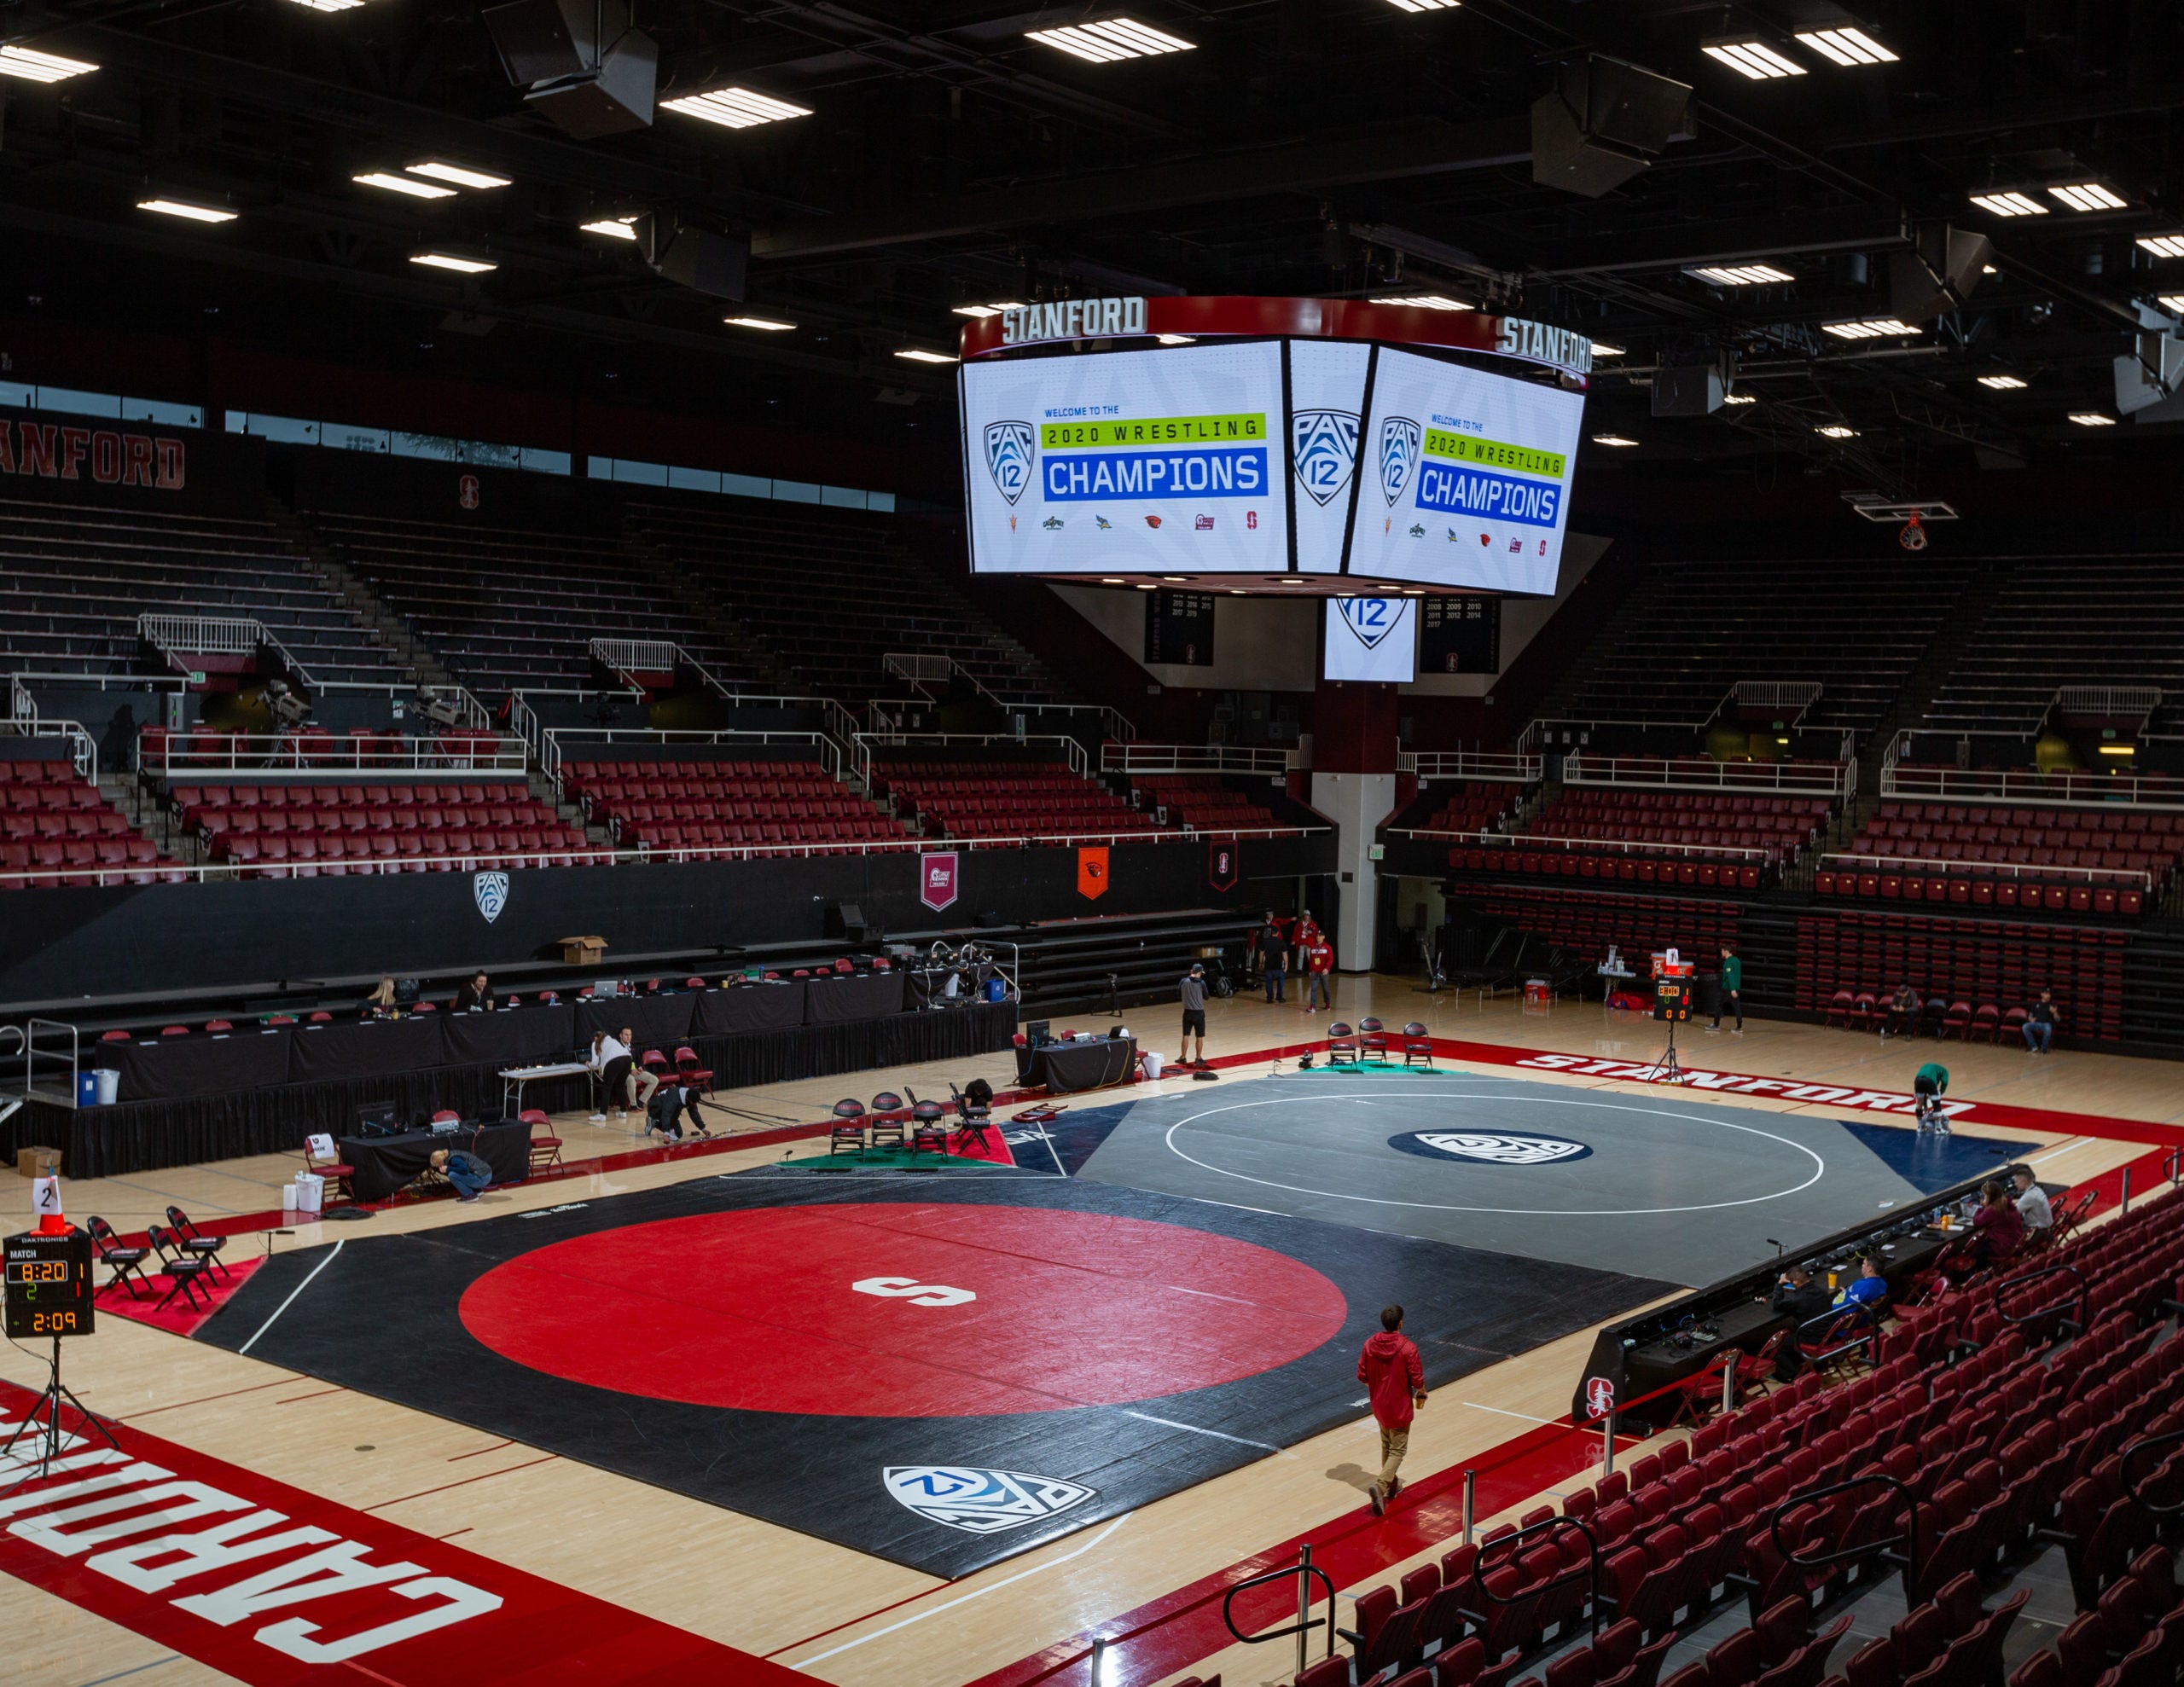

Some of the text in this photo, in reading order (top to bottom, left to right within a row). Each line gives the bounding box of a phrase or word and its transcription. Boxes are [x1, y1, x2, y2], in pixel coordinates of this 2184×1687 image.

[1002, 296, 1147, 344] STANFORD
[1502, 316, 1592, 374] STANFORD
[1045, 405, 1119, 417] WELCOME TO THE
[1432, 414, 1484, 432] WELCOME TO THE
[1048, 420, 1257, 443] 2020 WRESTLING
[1429, 435, 1560, 473] 2020 WRESTLING
[1002, 464, 1021, 488] 12
[1048, 455, 1260, 495] CHAMPIONS
[1310, 460, 1339, 485] 12
[1387, 464, 1403, 489] 12
[1420, 469, 1556, 521] CHAMPIONS
[1357, 597, 1388, 627] 12
[485, 899, 498, 913] 12
[1516, 1054, 1977, 1118] STANFORD
[41, 1187, 52, 1208] 2
[9, 1249, 37, 1260] MATCH
[22, 1262, 84, 1282] 8:20 1
[26, 1281, 80, 1301] 2 1
[852, 1277, 977, 1307] S
[33, 1311, 76, 1332] 2:09
[899, 1471, 976, 1497] 12
